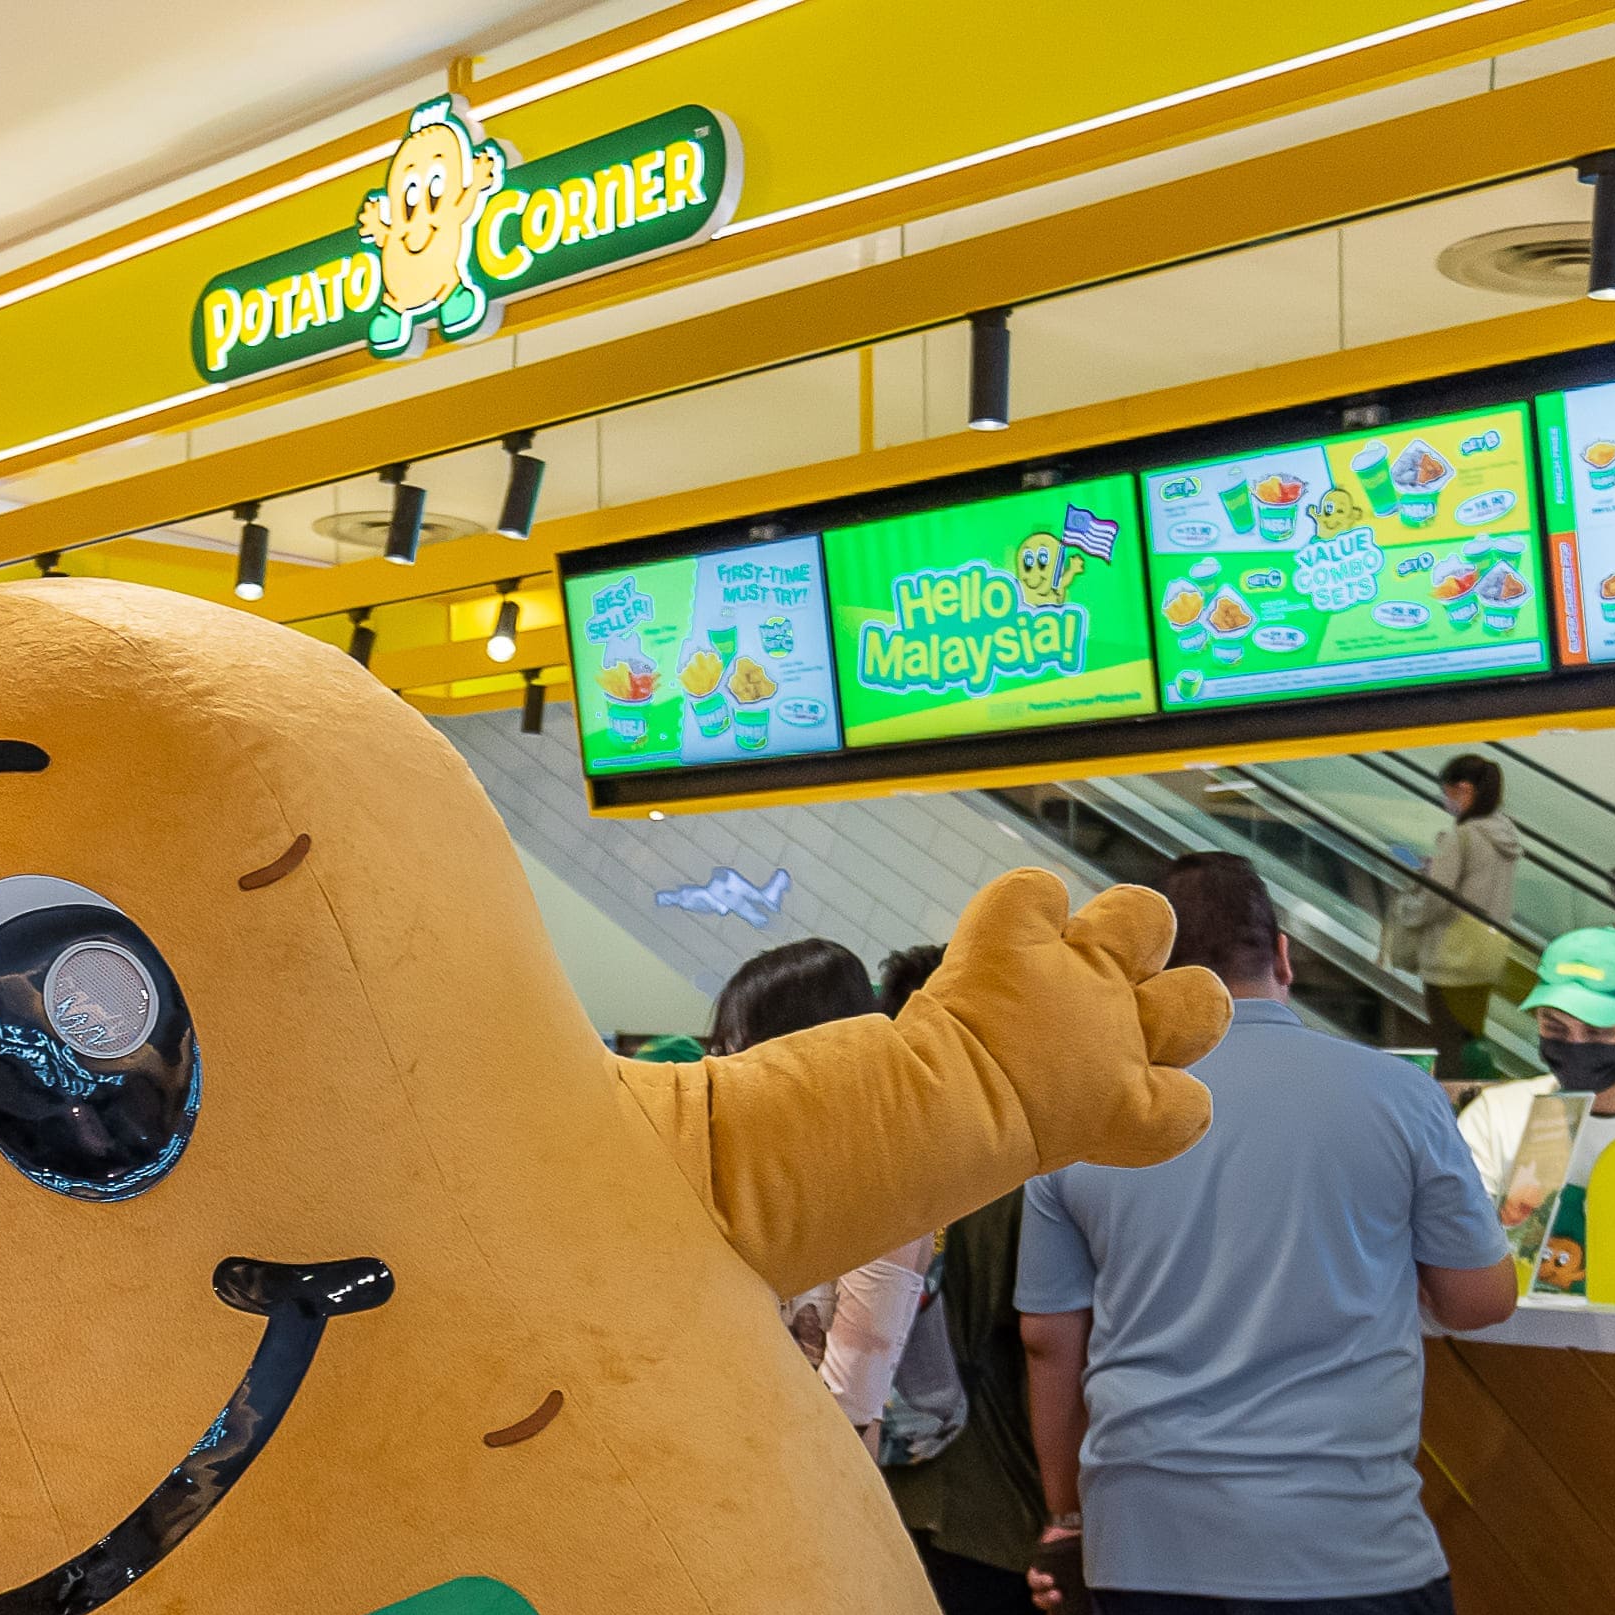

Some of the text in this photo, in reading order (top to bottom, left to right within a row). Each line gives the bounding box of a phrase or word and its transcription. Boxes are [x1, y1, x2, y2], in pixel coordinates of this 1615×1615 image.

[205, 139, 708, 371] POTATO CORNER
[1298, 532, 1369, 567] VALUE
[717, 563, 811, 583] FIRST-TIME
[1296, 553, 1380, 590] COMBO
[595, 582, 632, 615] BEST
[723, 584, 808, 605] MUST TRY!
[897, 570, 1012, 630] Hello
[1316, 580, 1373, 607] SETS
[588, 599, 649, 640] SELLER!
[865, 613, 1076, 684] Malaysia!
